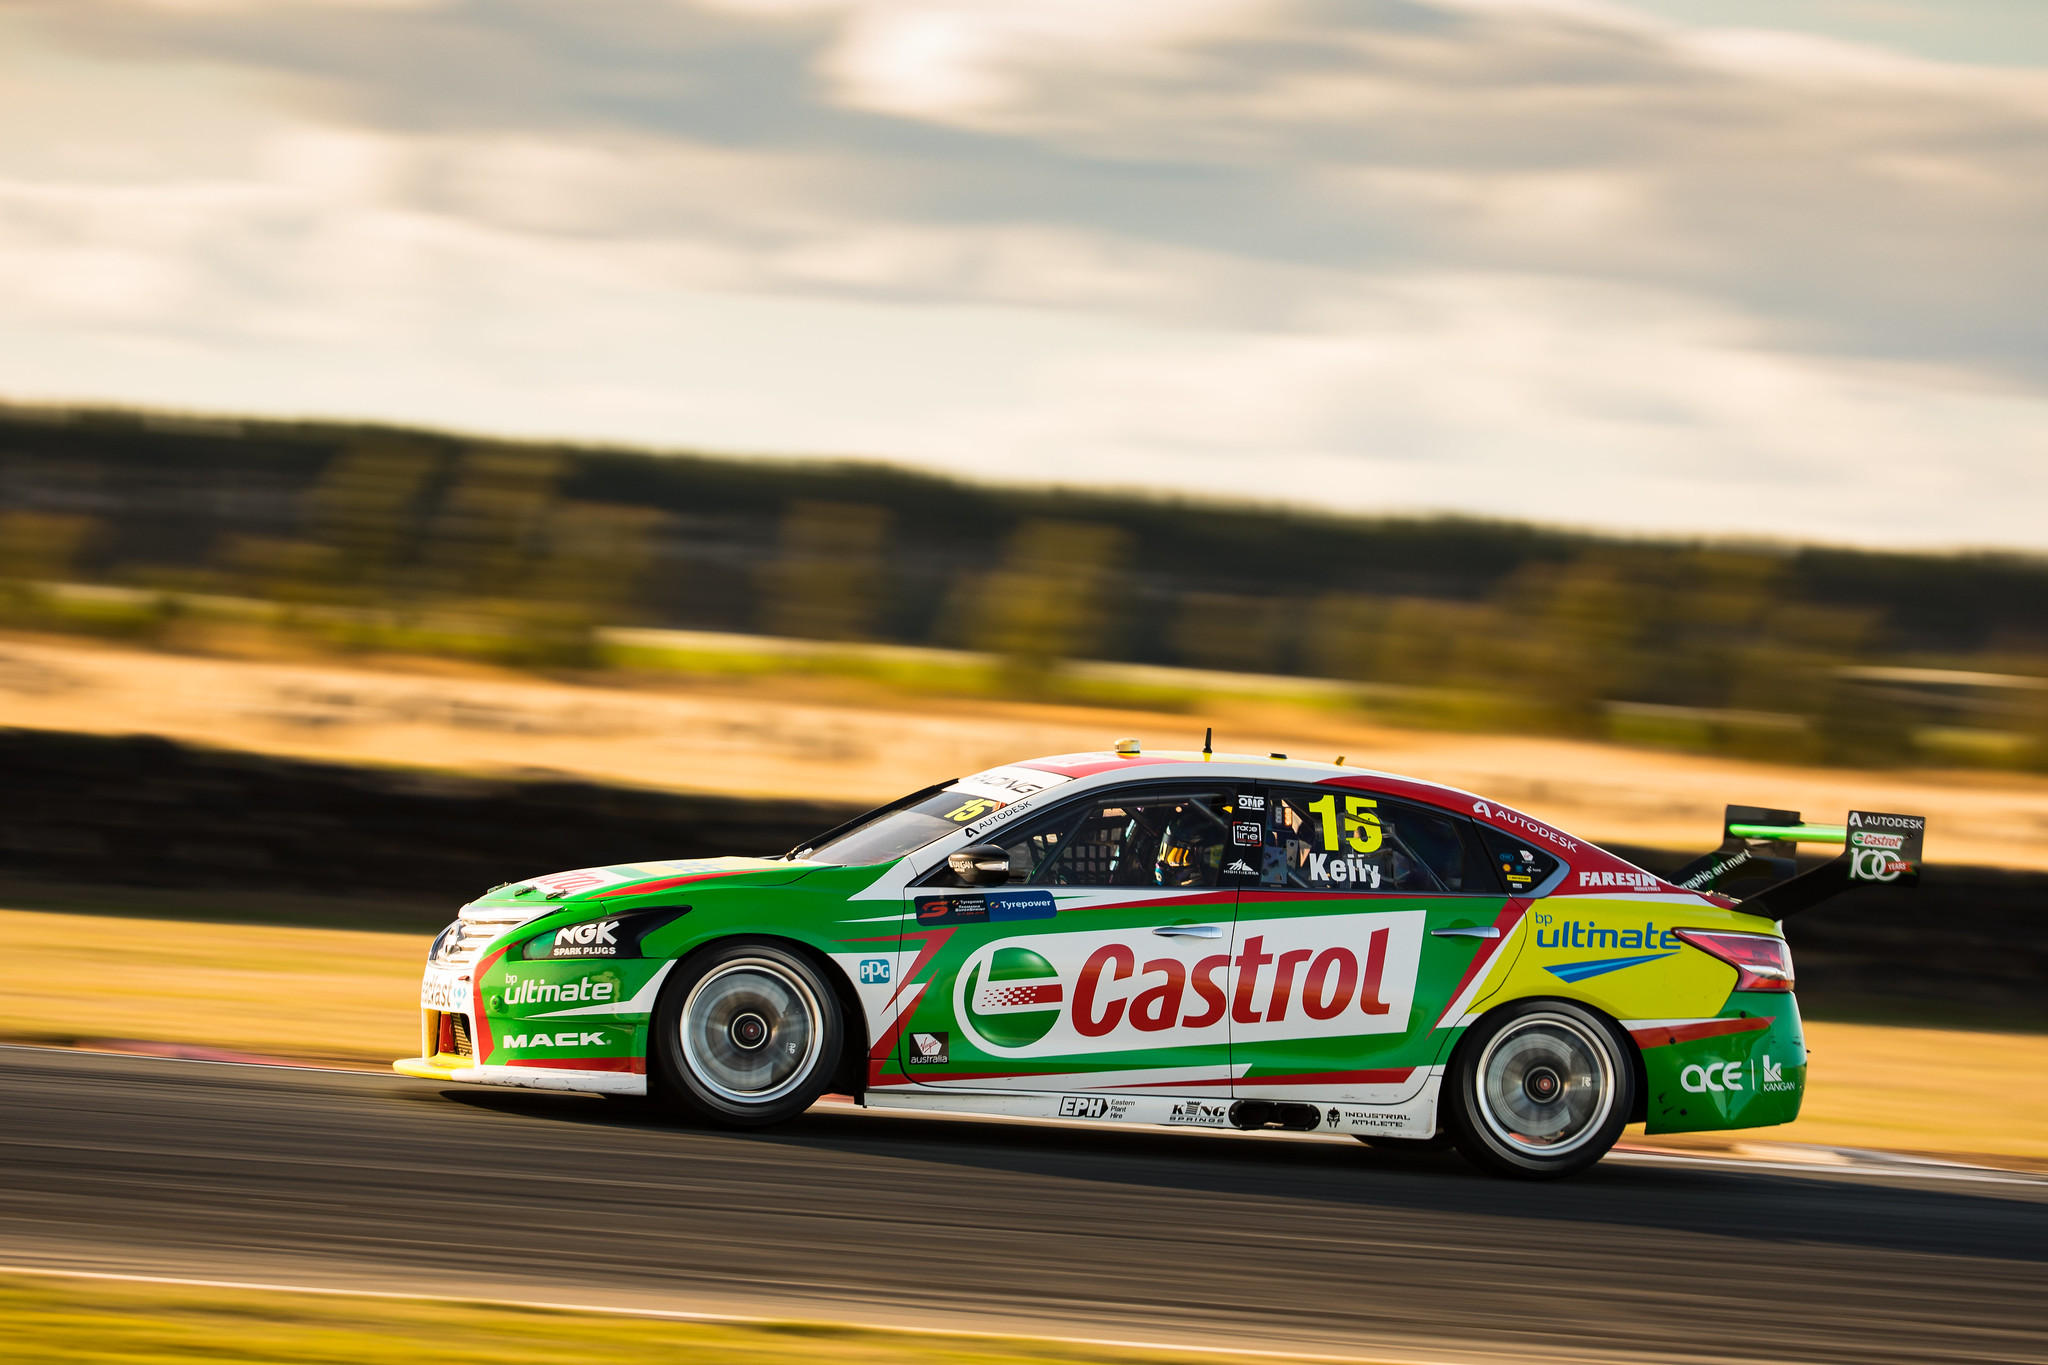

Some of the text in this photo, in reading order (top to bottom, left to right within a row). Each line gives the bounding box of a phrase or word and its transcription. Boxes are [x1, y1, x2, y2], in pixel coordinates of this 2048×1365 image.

[1239, 797, 1264, 808] OMP
[979, 801, 1032, 829] AUTODESK
[1865, 815, 1923, 829] AUTODESK
[1309, 795, 1382, 853] 15
[1496, 810, 1577, 853] AUTODESK
[1864, 834, 1900, 847] Castrol
[1712, 861, 1729, 876] art
[1726, 848, 1752, 868] mart
[1850, 847, 1901, 881] 100
[1887, 862, 1906, 871] YEARS
[1309, 853, 1381, 889] Kelly
[1579, 871, 1657, 887] FARESIN
[1000, 900, 1051, 910] Tyrepower
[1535, 912, 1553, 927] bp
[555, 921, 620, 946] NGK
[1536, 921, 1681, 950] ultimate
[553, 947, 616, 956] SPARK PLUGS
[505, 973, 518, 985] bp
[861, 961, 889, 982] PPG
[504, 976, 613, 1005] ultimate
[1071, 927, 1391, 1038] Castrol
[910, 1055, 948, 1064] australia
[1763, 1082, 1795, 1092] KANGAN
[1060, 1097, 1104, 1117] EPH
[1344, 1111, 1411, 1121] INDUSTRIAL
[1351, 1120, 1403, 1128] ATHLETE
